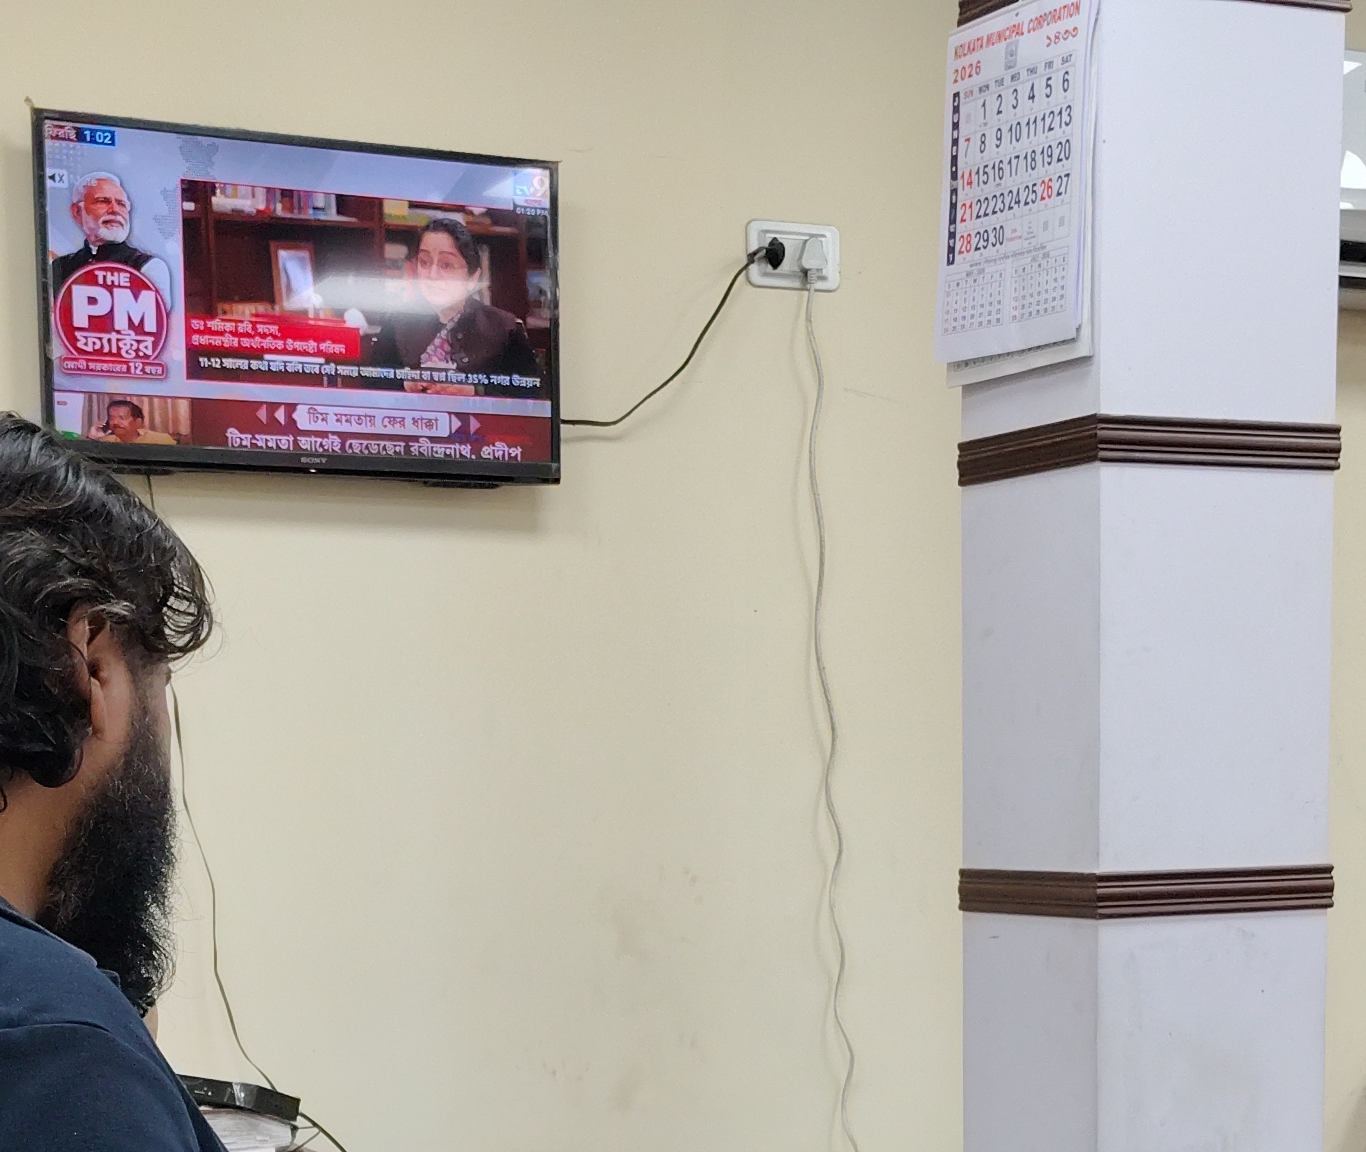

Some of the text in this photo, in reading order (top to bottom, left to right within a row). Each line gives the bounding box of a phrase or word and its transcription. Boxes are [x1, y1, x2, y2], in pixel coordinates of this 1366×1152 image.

[954, 1, 1081, 60] KOLKATA MUNICIPAL CORPORATION
[953, 60, 981, 84] 2026
[1026, 66, 1038, 77] THU
[1044, 60, 1054, 72] FRI
[1060, 54, 1073, 65] SAT
[981, 71, 1069, 120] 1 2 3 4 5 6
[84, 131, 112, 144] 1:02
[965, 105, 1072, 158] 7 8 9 10 11 12 13
[961, 139, 1071, 191] 14 15 16 17 18 19 20
[960, 173, 1070, 223] 21 22 23 24 25 26 27
[958, 225, 1005, 255] 28 29 30
[94, 270, 131, 287] THE
[72, 284, 157, 333] PM
[75, 330, 155, 359] ফ্যাক্টর
[129, 362, 144, 375] 12
[199, 357, 222, 368] 11-12
[467, 374, 489, 385] 35%
[306, 408, 439, 432] টিম মমতায় ফের ধাক্কা
[225, 427, 295, 451] টিম-মমতা
[297, 433, 341, 453] আগেই
[300, 456, 327, 465] SONY
